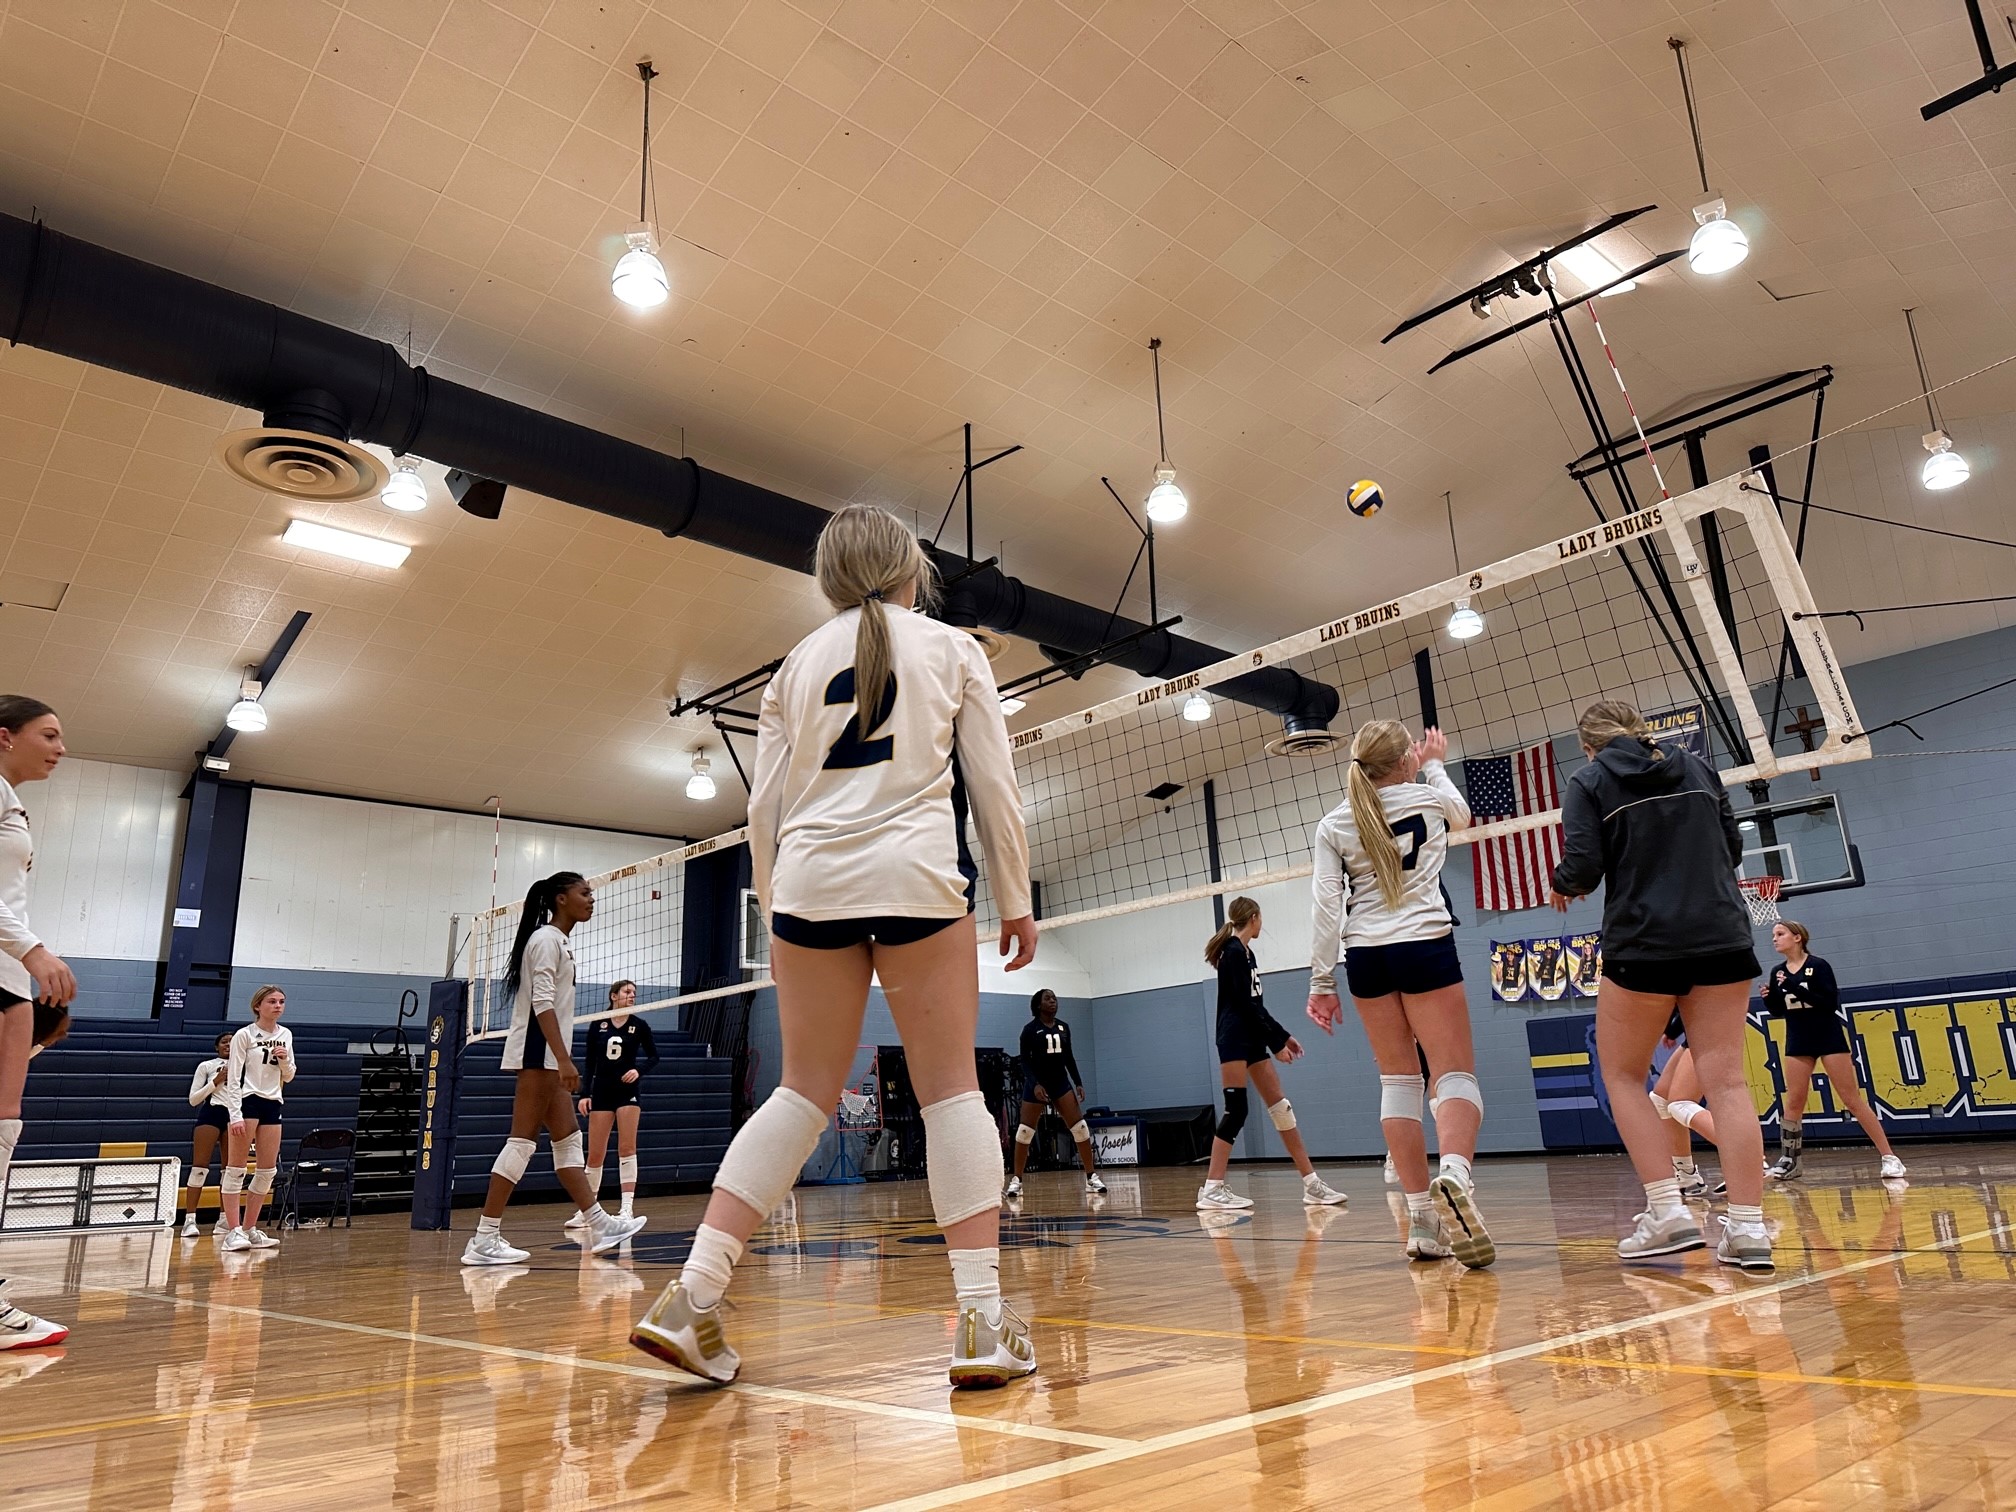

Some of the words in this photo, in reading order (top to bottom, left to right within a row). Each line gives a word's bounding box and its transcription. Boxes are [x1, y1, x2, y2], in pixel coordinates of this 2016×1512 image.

[1557, 531, 1598, 559] LADY
[1603, 508, 1663, 543] BRUINS
[1320, 619, 1351, 642] LADY
[1354, 602, 1401, 630] BRUINS
[1137, 686, 1161, 706] LADY
[1164, 673, 1200, 696] BRUINS
[822, 666, 898, 771] 2
[1645, 710, 1697, 732] RUINS
[1014, 728, 1043, 748] BRUINS
[606, 1036, 623, 1060] 6
[1045, 1033, 1063, 1054] 11
[422, 1050, 439, 1170] BRUINS
[1100, 1129, 1134, 1157] Joseph
